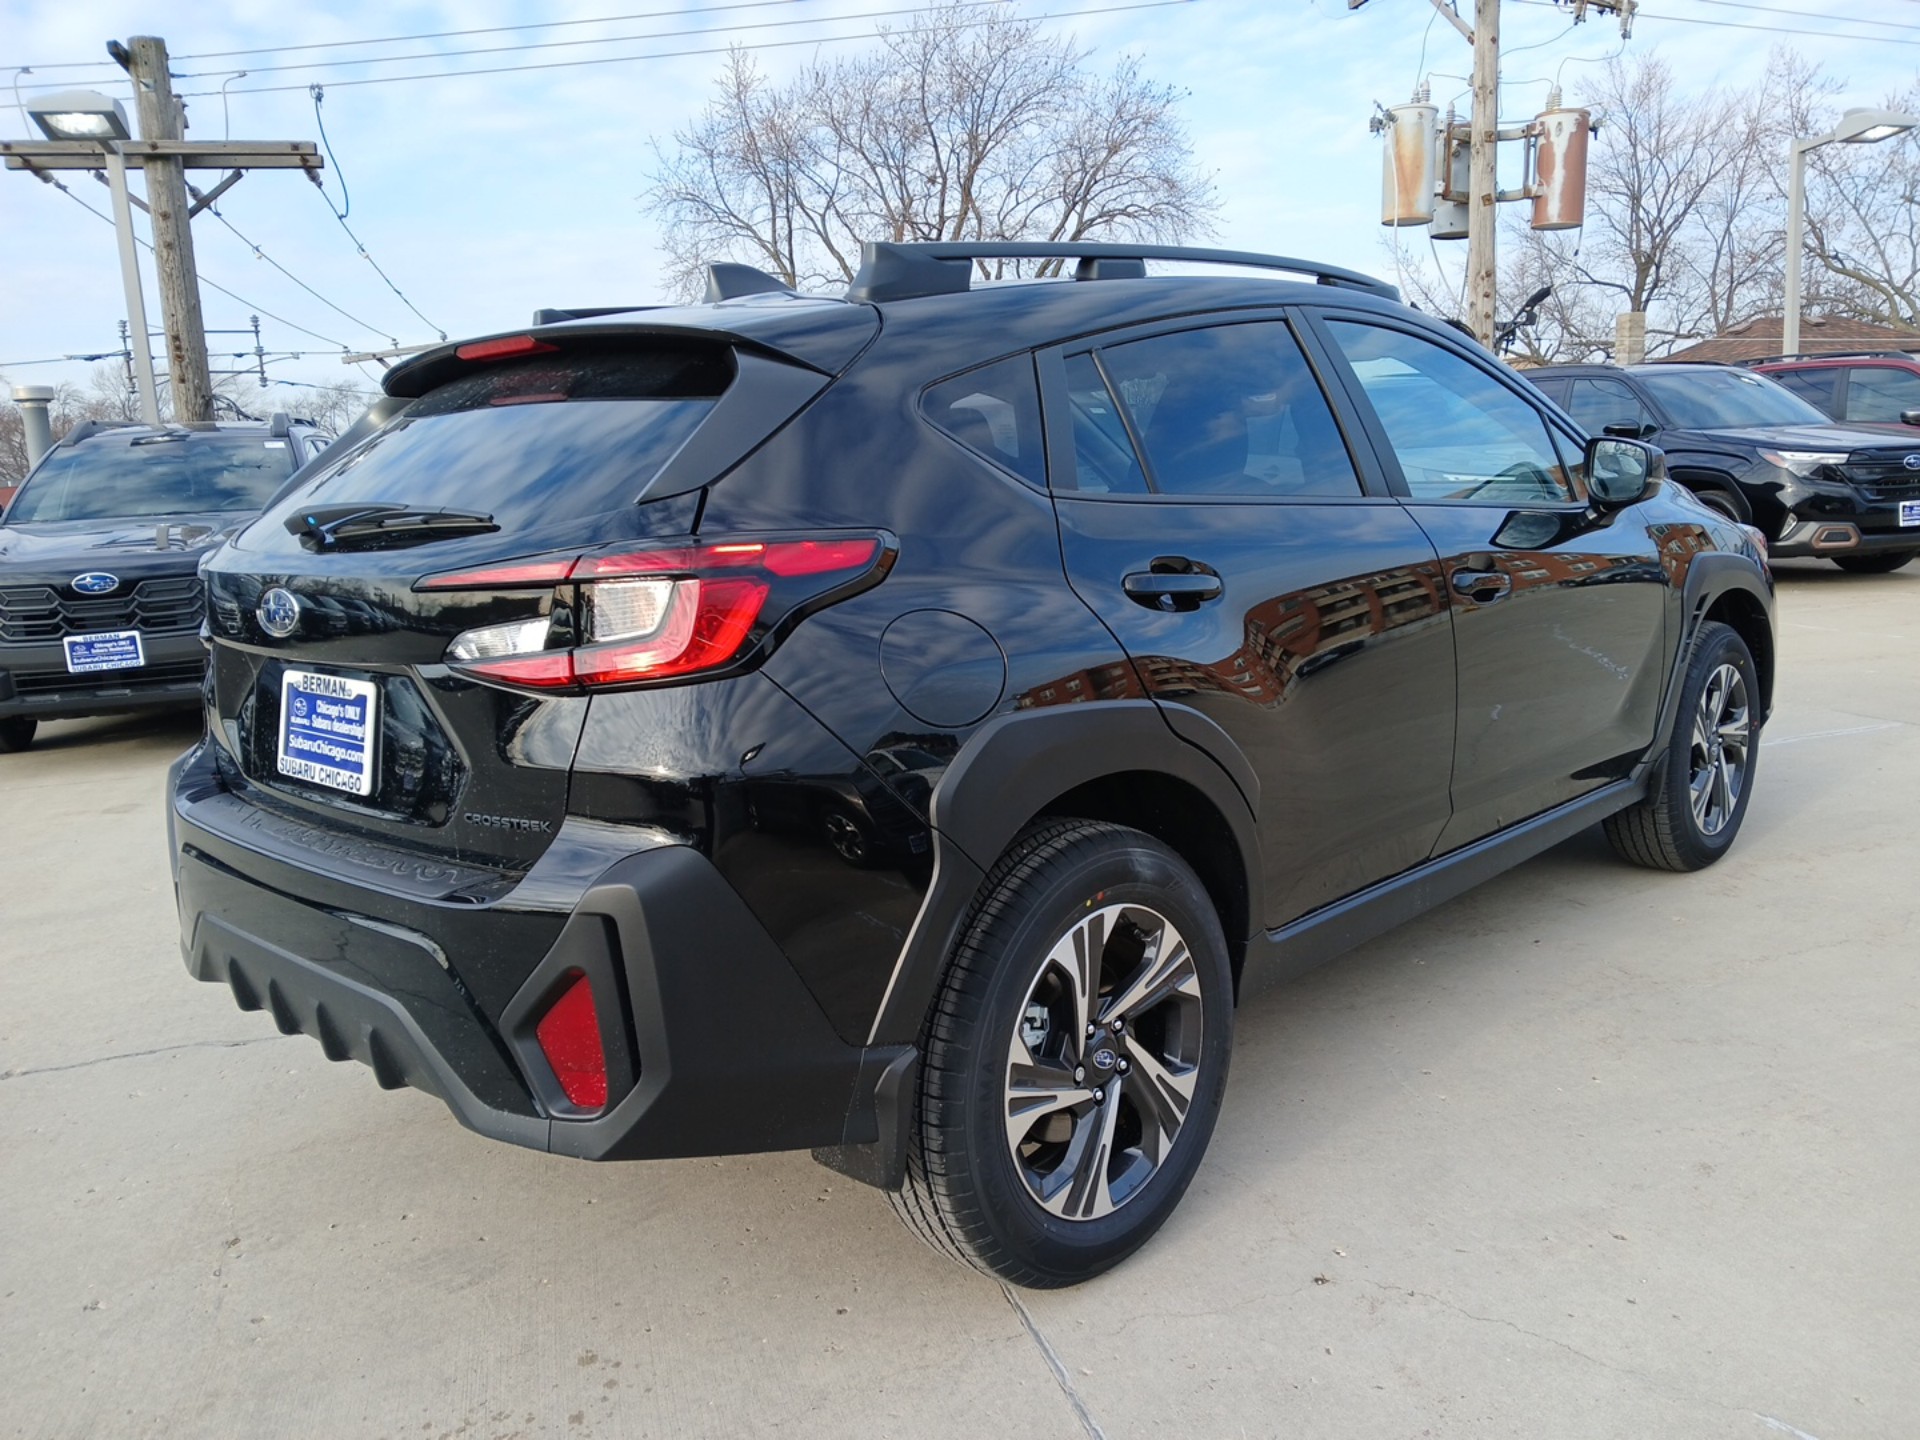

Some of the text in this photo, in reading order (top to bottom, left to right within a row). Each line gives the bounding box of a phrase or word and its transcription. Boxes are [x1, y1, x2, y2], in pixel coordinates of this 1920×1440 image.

[302, 675, 347, 697] BERMAN
[316, 700, 361, 720] Chicago's ONLY
[311, 714, 332, 731] Subaru
[289, 734, 364, 762] SubaruChicago.com
[279, 757, 362, 792] SUBARU CHICAGO
[464, 812, 552, 833] CROSSTREK
